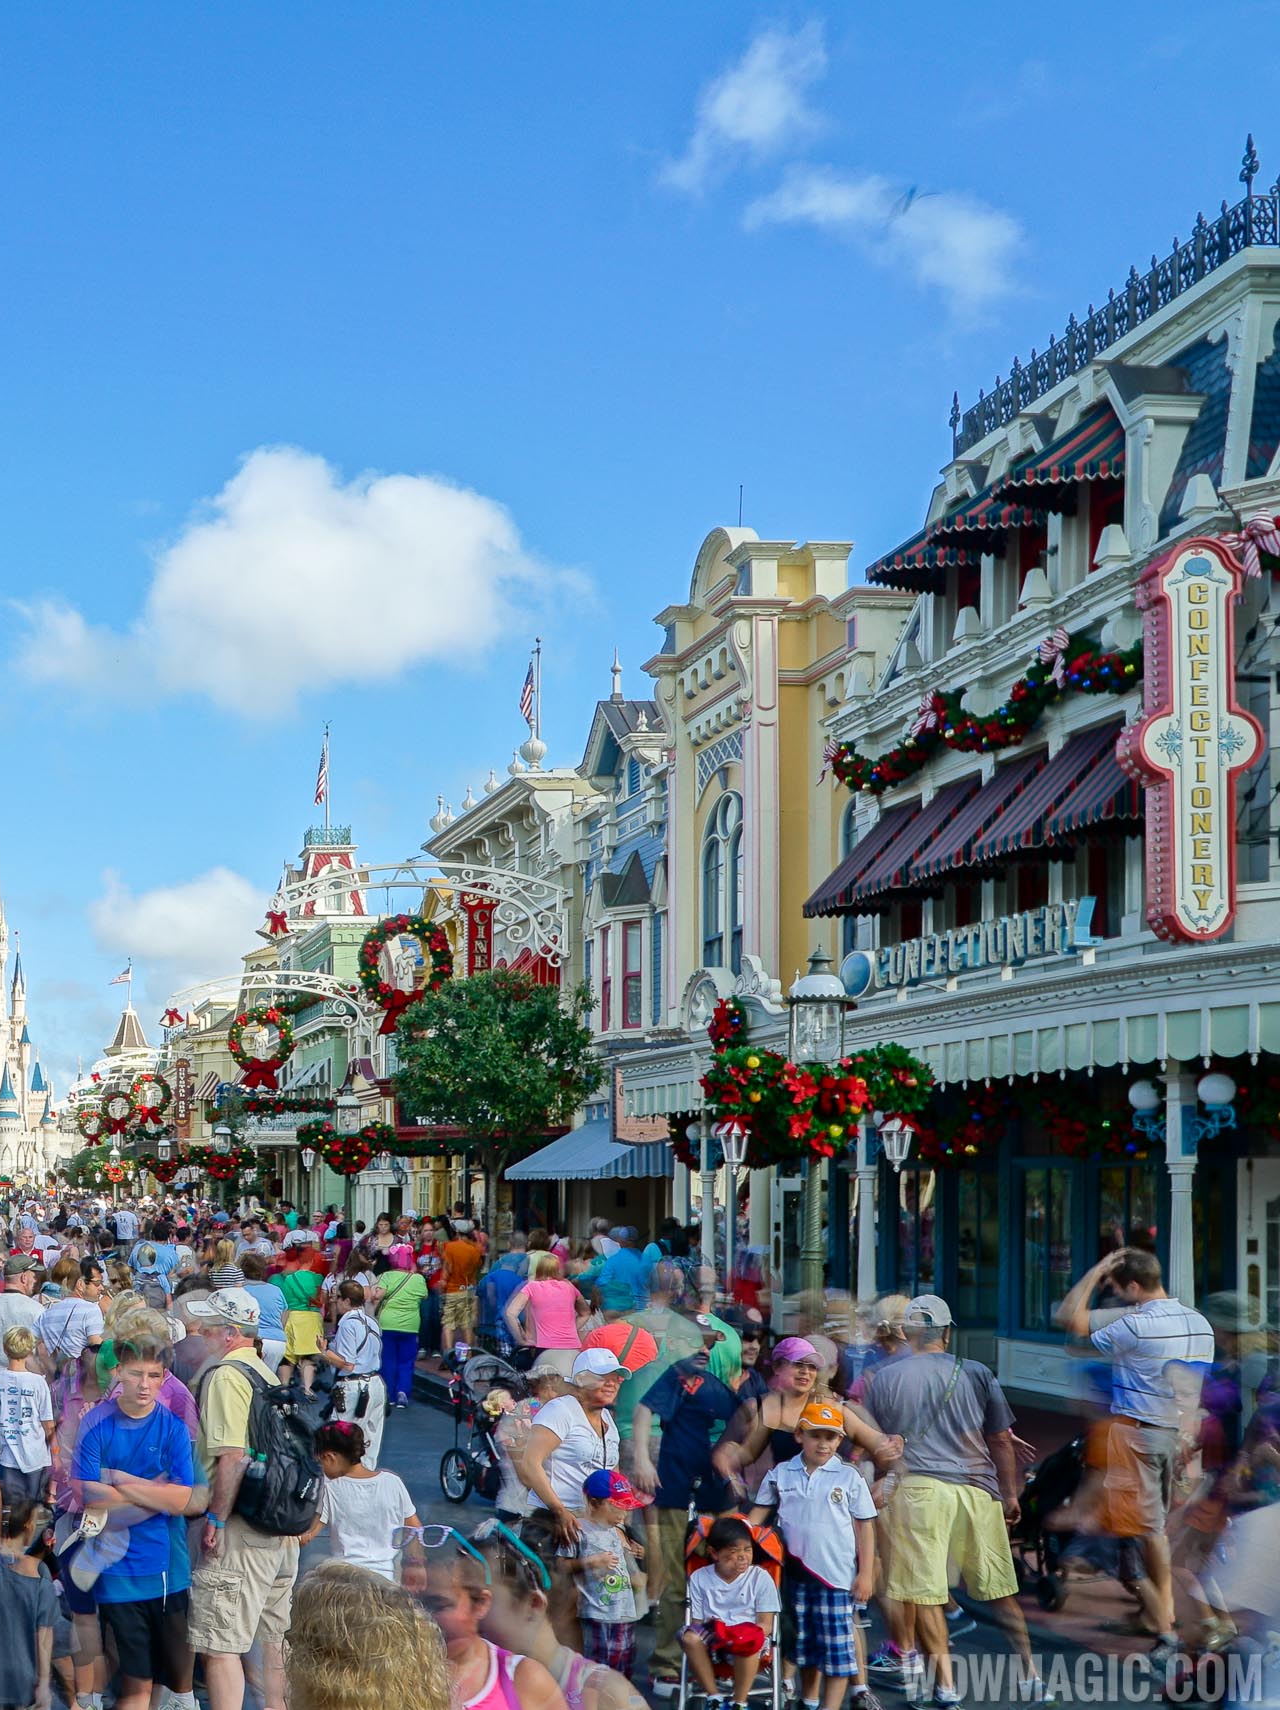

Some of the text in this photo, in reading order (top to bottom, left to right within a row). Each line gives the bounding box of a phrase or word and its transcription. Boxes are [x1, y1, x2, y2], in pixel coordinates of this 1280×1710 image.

[1187, 582, 1215, 911] CONFECTIONERY
[473, 909, 490, 971] CINE
[873, 899, 1081, 989] CONFECTIONERY
[178, 1067, 186, 1097] CRYSTAL
